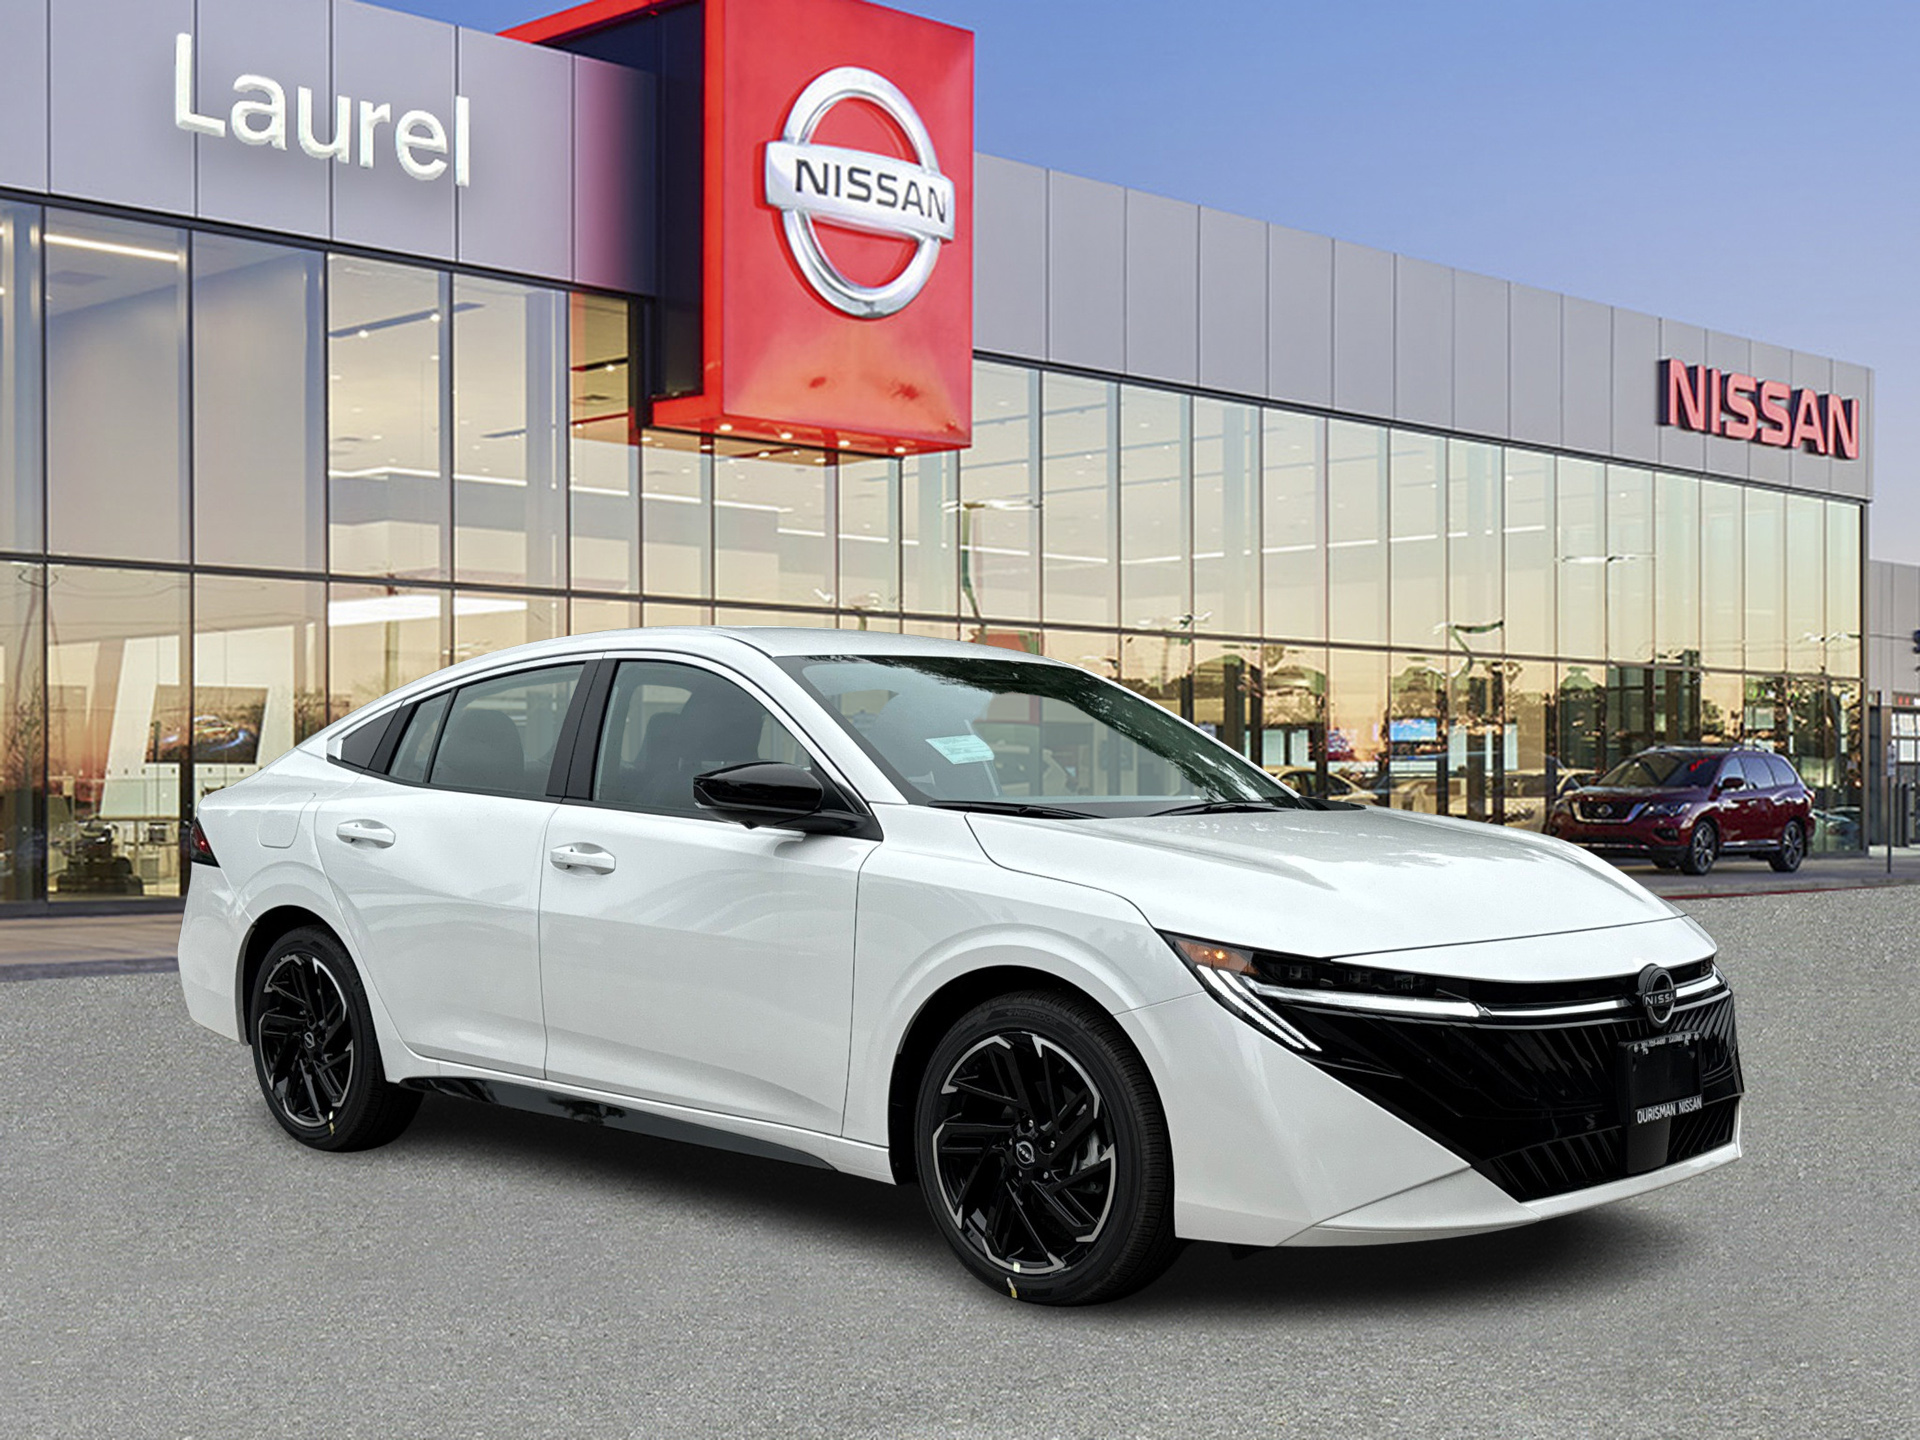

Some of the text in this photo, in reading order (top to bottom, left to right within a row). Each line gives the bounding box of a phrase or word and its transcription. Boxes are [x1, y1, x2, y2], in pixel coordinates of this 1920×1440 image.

[175, 32, 470, 187] Laurel
[795, 158, 946, 223] NISSAN
[1665, 358, 1860, 460] NISSAN
[1644, 992, 1674, 1006] NISSA
[1637, 1095, 1702, 1124] OURISMAN NISSAN
